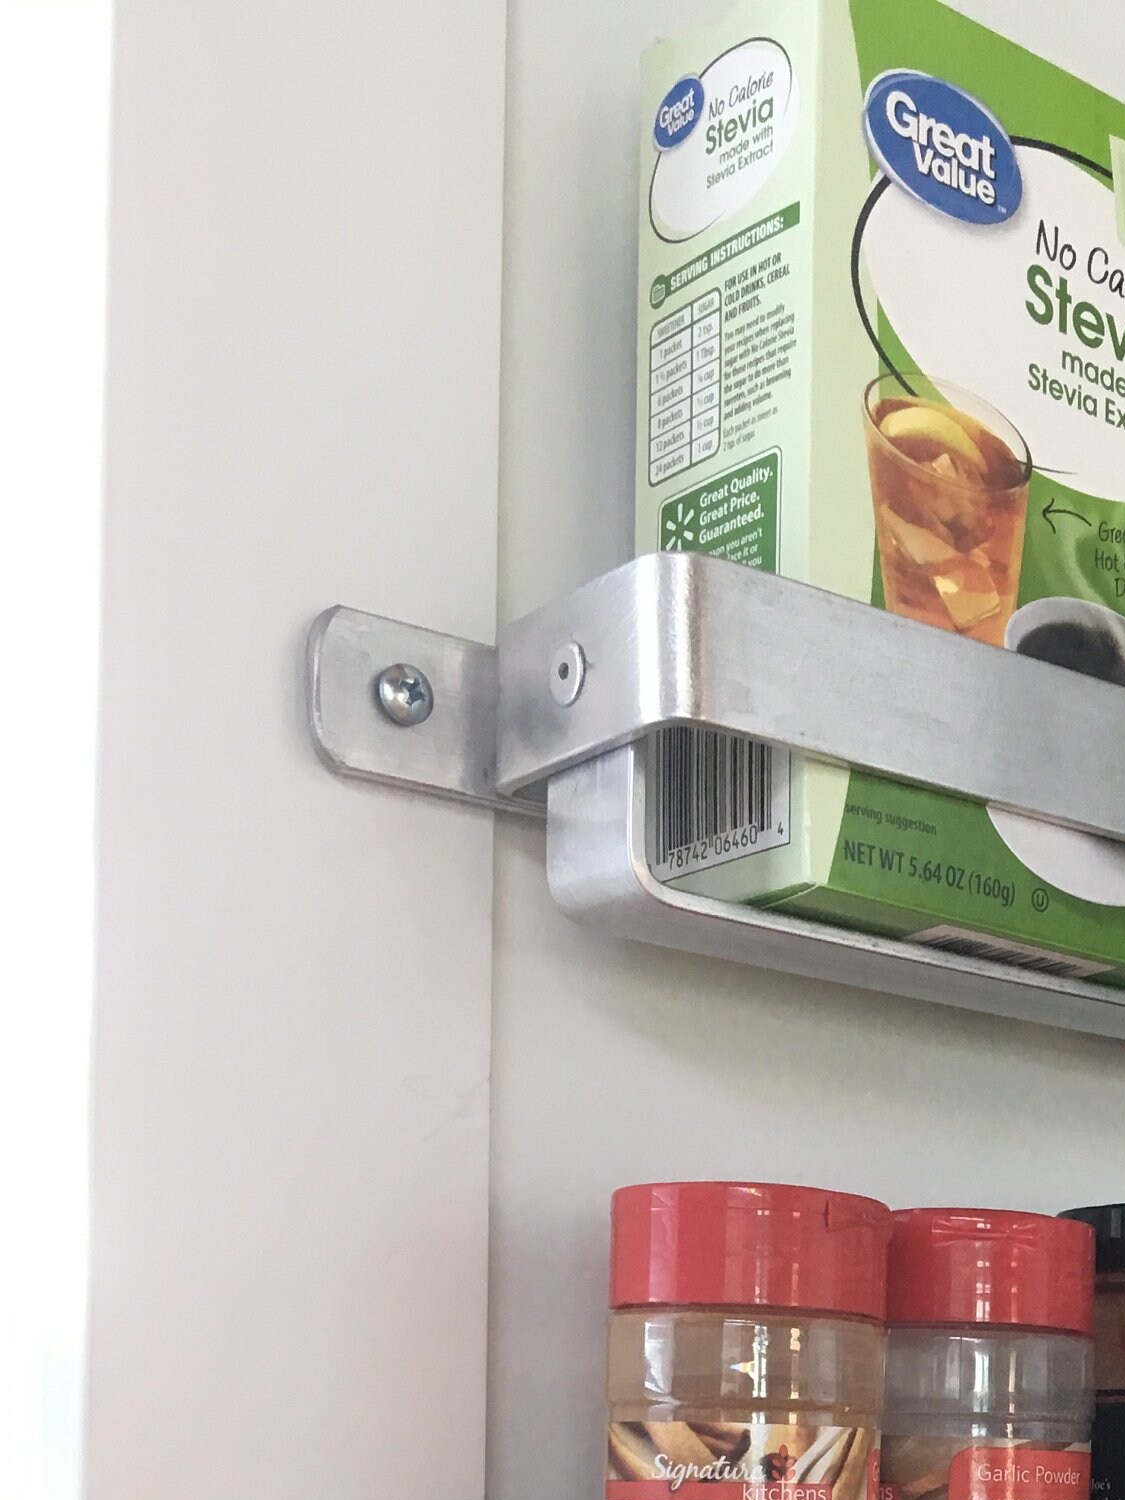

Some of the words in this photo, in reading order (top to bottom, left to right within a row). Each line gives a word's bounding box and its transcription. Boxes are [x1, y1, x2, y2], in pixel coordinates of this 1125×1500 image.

[659, 88, 695, 128] Great
[708, 98, 724, 121] No
[728, 71, 774, 106] Calorie
[667, 109, 695, 135] Value
[705, 97, 774, 155] Stevia
[886, 90, 996, 178] Great
[706, 163, 736, 189] Stevia
[738, 140, 774, 171] Extract
[719, 137, 750, 164] made
[752, 125, 774, 145] with
[914, 142, 996, 205] Value
[670, 257, 709, 290] SERVING
[710, 217, 784, 264] INSTRUCTIONS:
[1036, 219, 1076, 270] No
[767, 264, 790, 284] CEREAL
[1028, 362, 1098, 417] Stevia
[700, 484, 728, 507] Great
[730, 466, 773, 493] Quality.
[699, 504, 764, 544] Guaranteed.
[700, 502, 727, 526] Great
[730, 491, 760, 512] Price.
[1095, 549, 1120, 573] Hot
[845, 803, 882, 831] serving
[885, 812, 937, 837] suggestion
[668, 841, 708, 870] 78742
[714, 825, 758, 855] 06460
[777, 822, 784, 836] 4
[844, 841, 874, 867] NET
[879, 848, 905, 874] WT
[909, 856, 941, 884] 5.64
[946, 864, 965, 890] OZ
[968, 868, 1017, 907] (160g)
[651, 1453, 766, 1490] Signature
[978, 1464, 1031, 1483] Garlic
[1036, 1466, 1080, 1485] Powder
